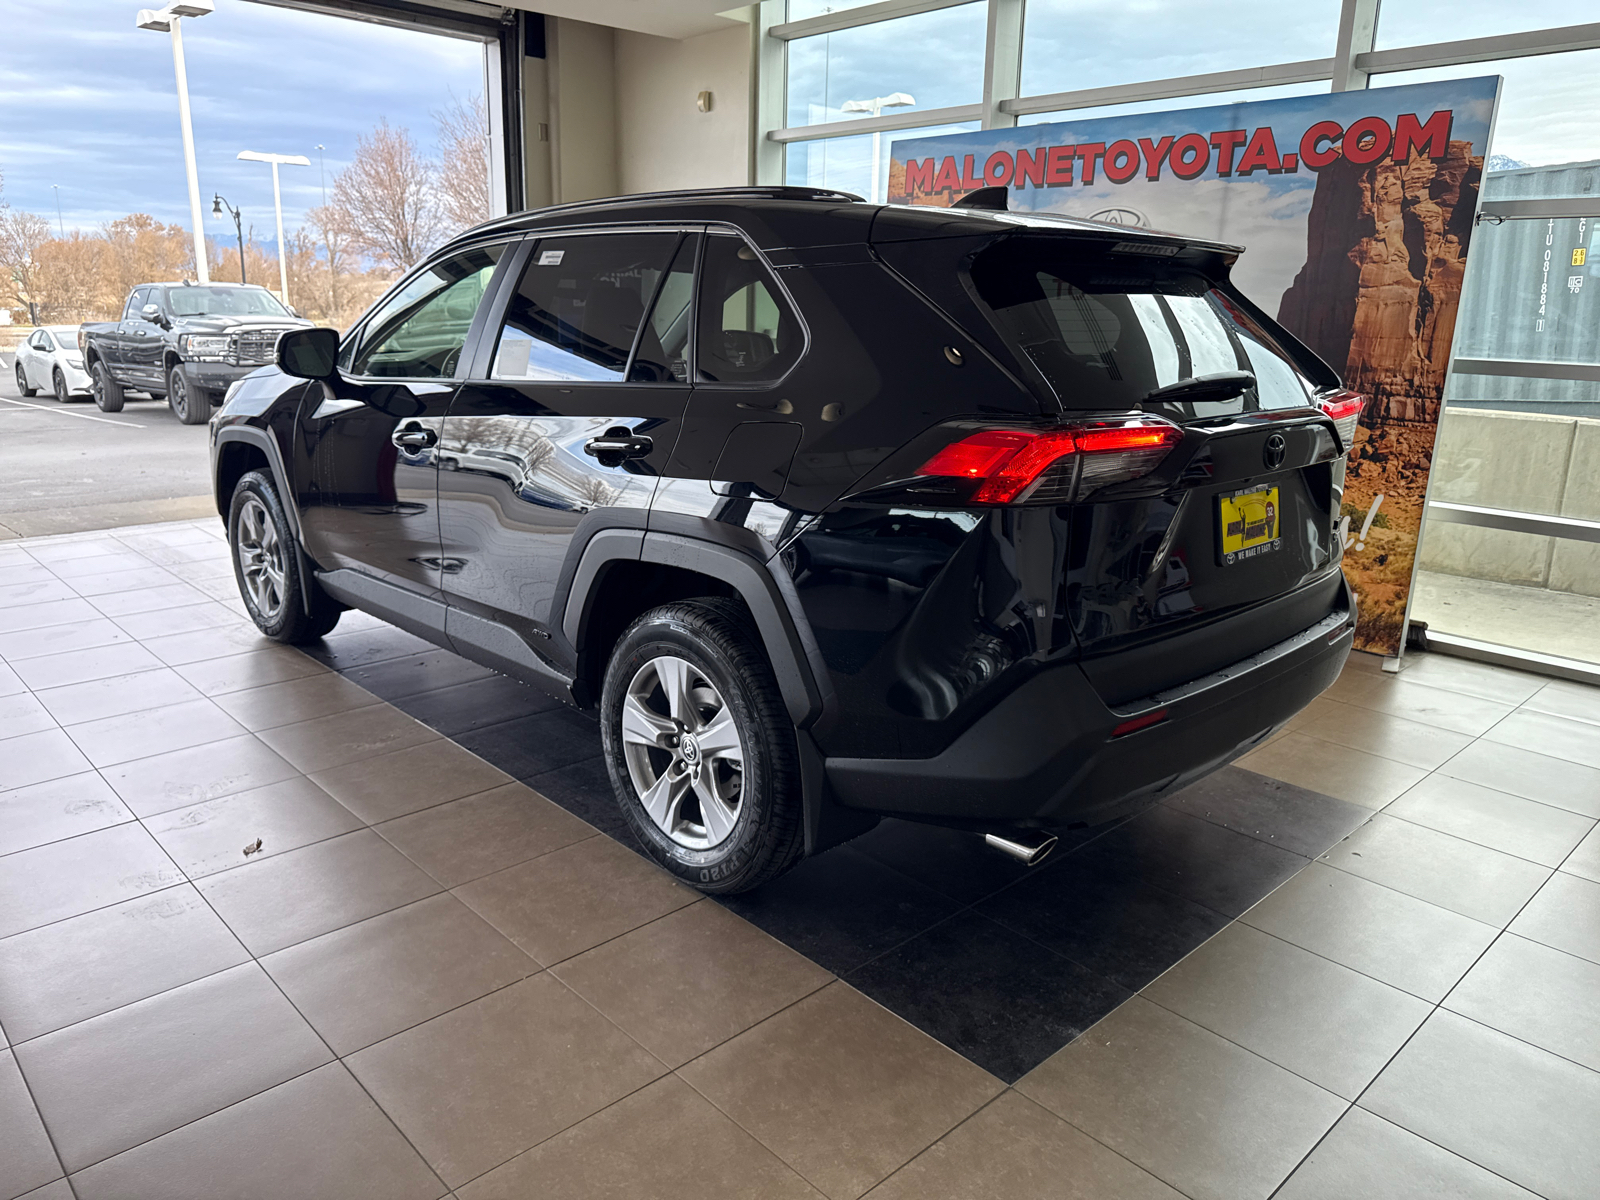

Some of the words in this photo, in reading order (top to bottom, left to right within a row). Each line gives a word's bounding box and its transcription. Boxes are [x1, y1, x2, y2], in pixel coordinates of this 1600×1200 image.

[904, 109, 1453, 195] MALONETOYOTA.COM
[1545, 218, 1555, 246] TU
[1538, 249, 1551, 316] 081884
[1266, 506, 1274, 517] 32
